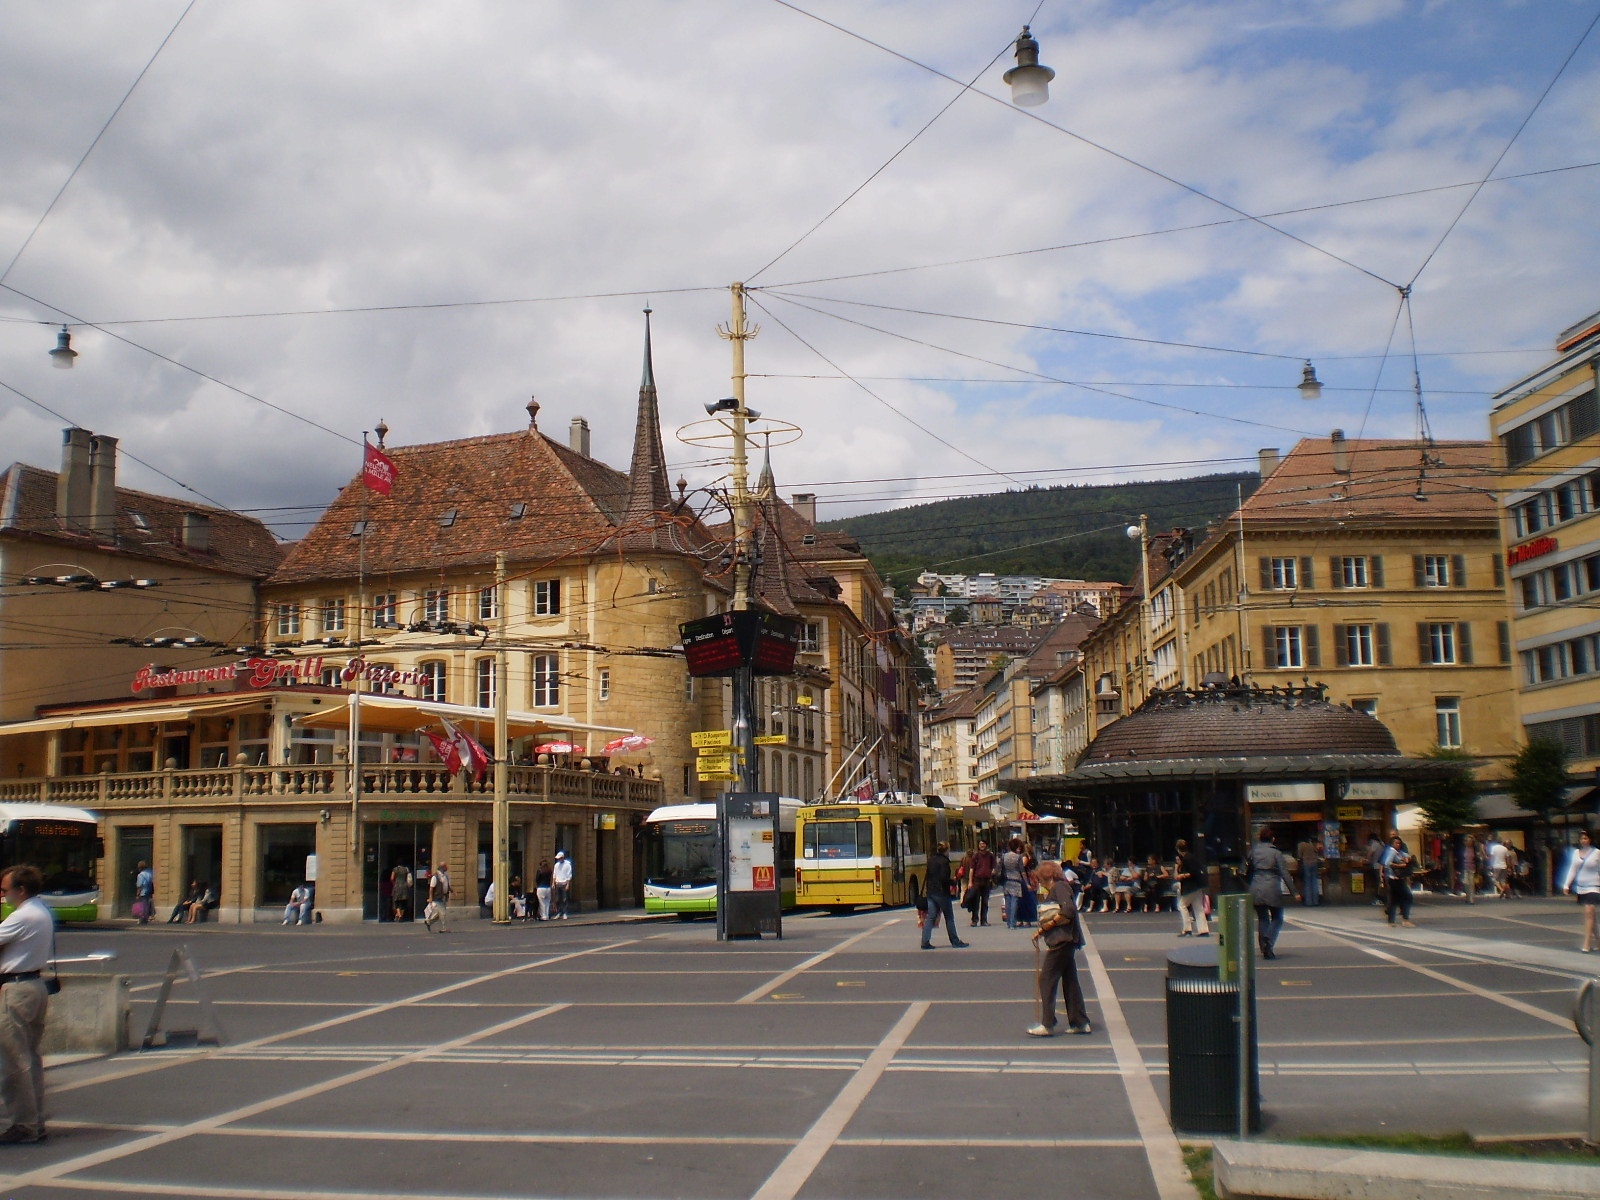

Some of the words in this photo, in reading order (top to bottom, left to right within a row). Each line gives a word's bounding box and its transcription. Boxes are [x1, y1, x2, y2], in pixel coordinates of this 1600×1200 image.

[131, 663, 238, 693] Restaurant
[246, 656, 323, 688] Grill
[340, 654, 430, 687] Pizzeria
